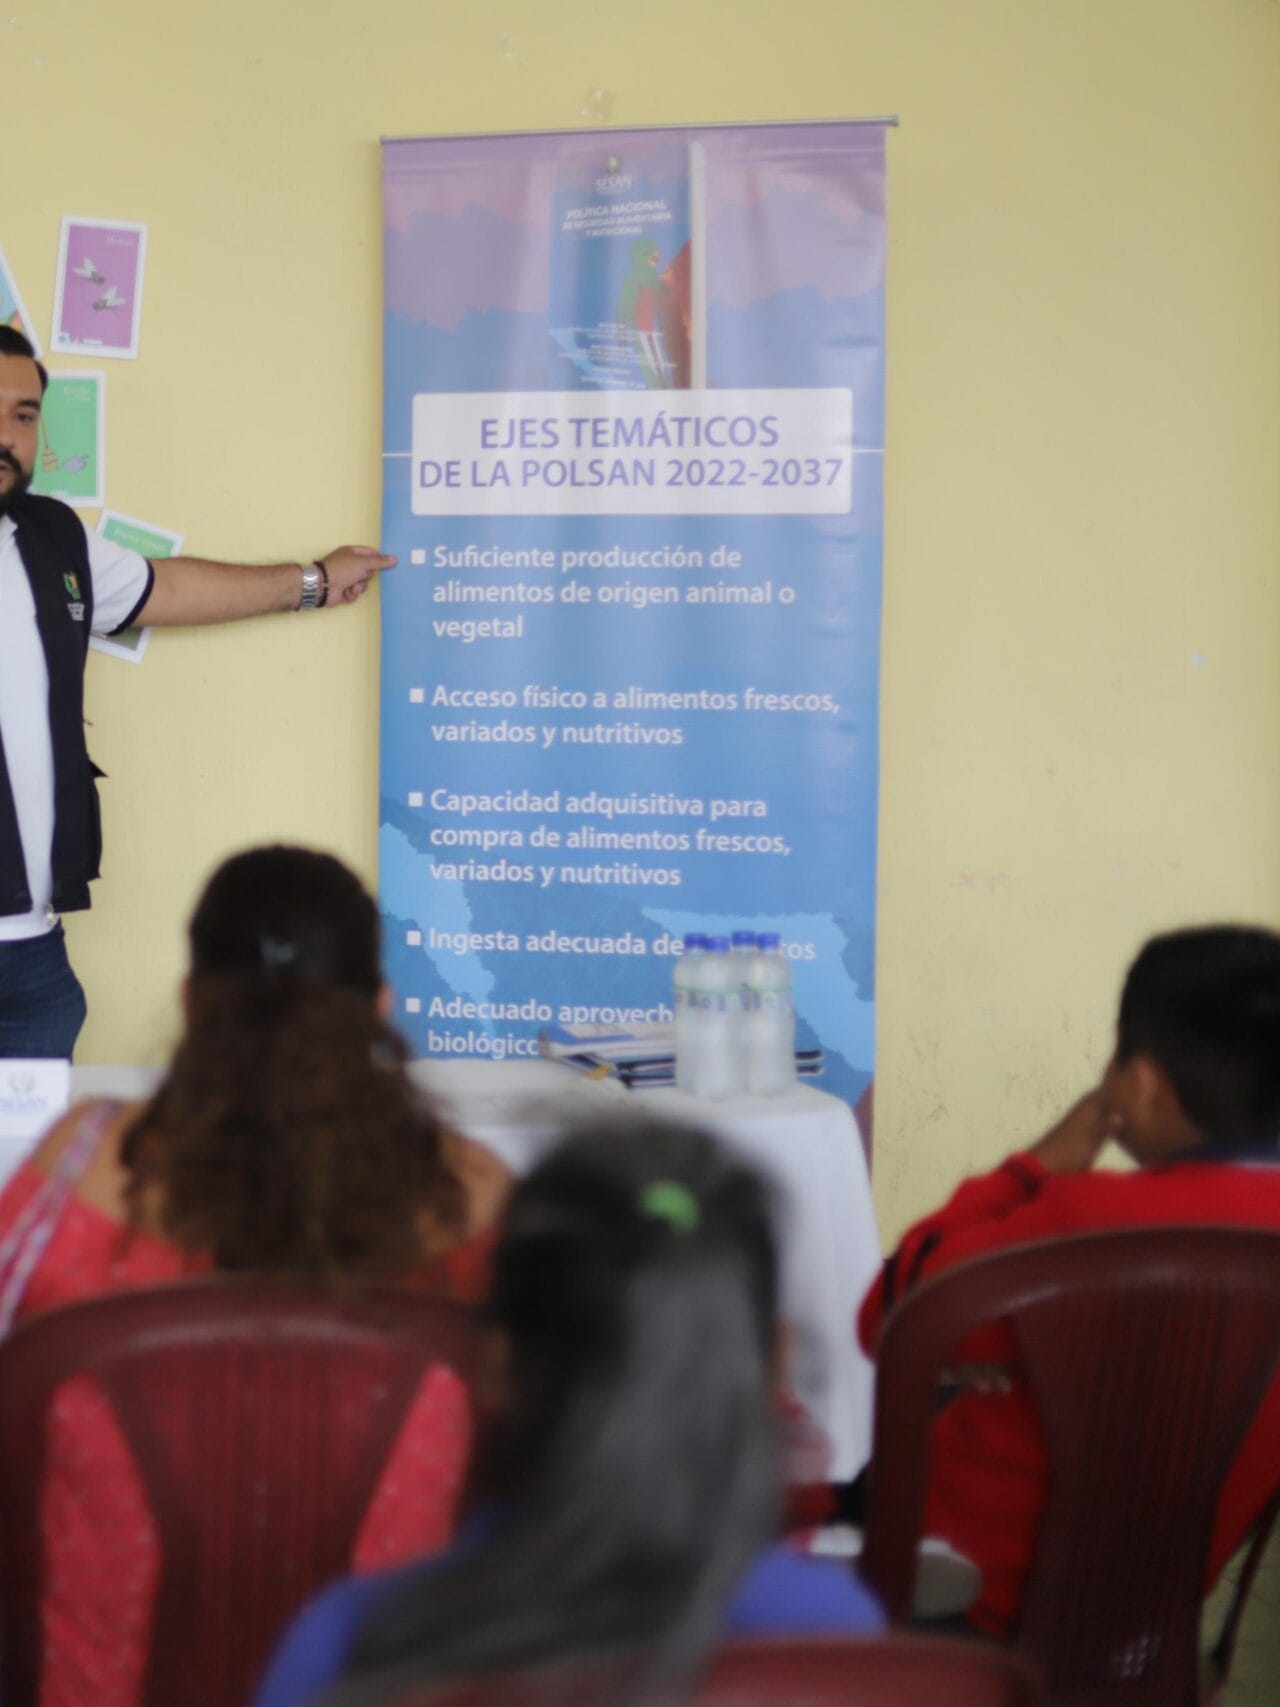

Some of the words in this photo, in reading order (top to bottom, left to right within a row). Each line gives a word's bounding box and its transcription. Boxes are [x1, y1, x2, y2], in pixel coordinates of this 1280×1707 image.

[480, 418, 560, 449] EJES
[568, 411, 780, 449] TEMÁTICOS
[420, 460, 462, 488] DE
[471, 460, 510, 488] LA
[521, 459, 656, 488] POLSAN
[665, 458, 843, 488] 2022-2037
[434, 546, 556, 567] Suficiente
[562, 546, 703, 572] producción
[710, 547, 742, 567] de
[433, 581, 555, 602] alimentos
[561, 581, 591, 602] de
[598, 583, 680, 608] origen
[686, 582, 772, 603] animal
[779, 588, 795, 603] o
[433, 616, 523, 643] vegetal
[431, 685, 517, 708] Acceso
[523, 685, 587, 708] físico
[593, 693, 607, 708] a
[616, 687, 738, 709] alimentos
[744, 688, 841, 713] frescos,
[431, 720, 536, 742] variados
[542, 728, 557, 748] y
[563, 722, 683, 744] nutritivos
[430, 790, 559, 816] Capacidad
[566, 791, 703, 820] adquisitiva
[711, 800, 767, 819] para
[430, 828, 523, 851] compra
[530, 826, 560, 848] de
[567, 827, 690, 850] alimentos
[696, 829, 791, 856] frescos,
[429, 860, 534, 882] variados
[540, 868, 555, 888] y
[561, 863, 682, 885] nutritivos
[429, 929, 520, 957] Ingesta
[525, 931, 647, 954] adecuada
[653, 932, 684, 955] de
[428, 996, 553, 1021] Adecuado
[558, 1002, 673, 1024] aprovech
